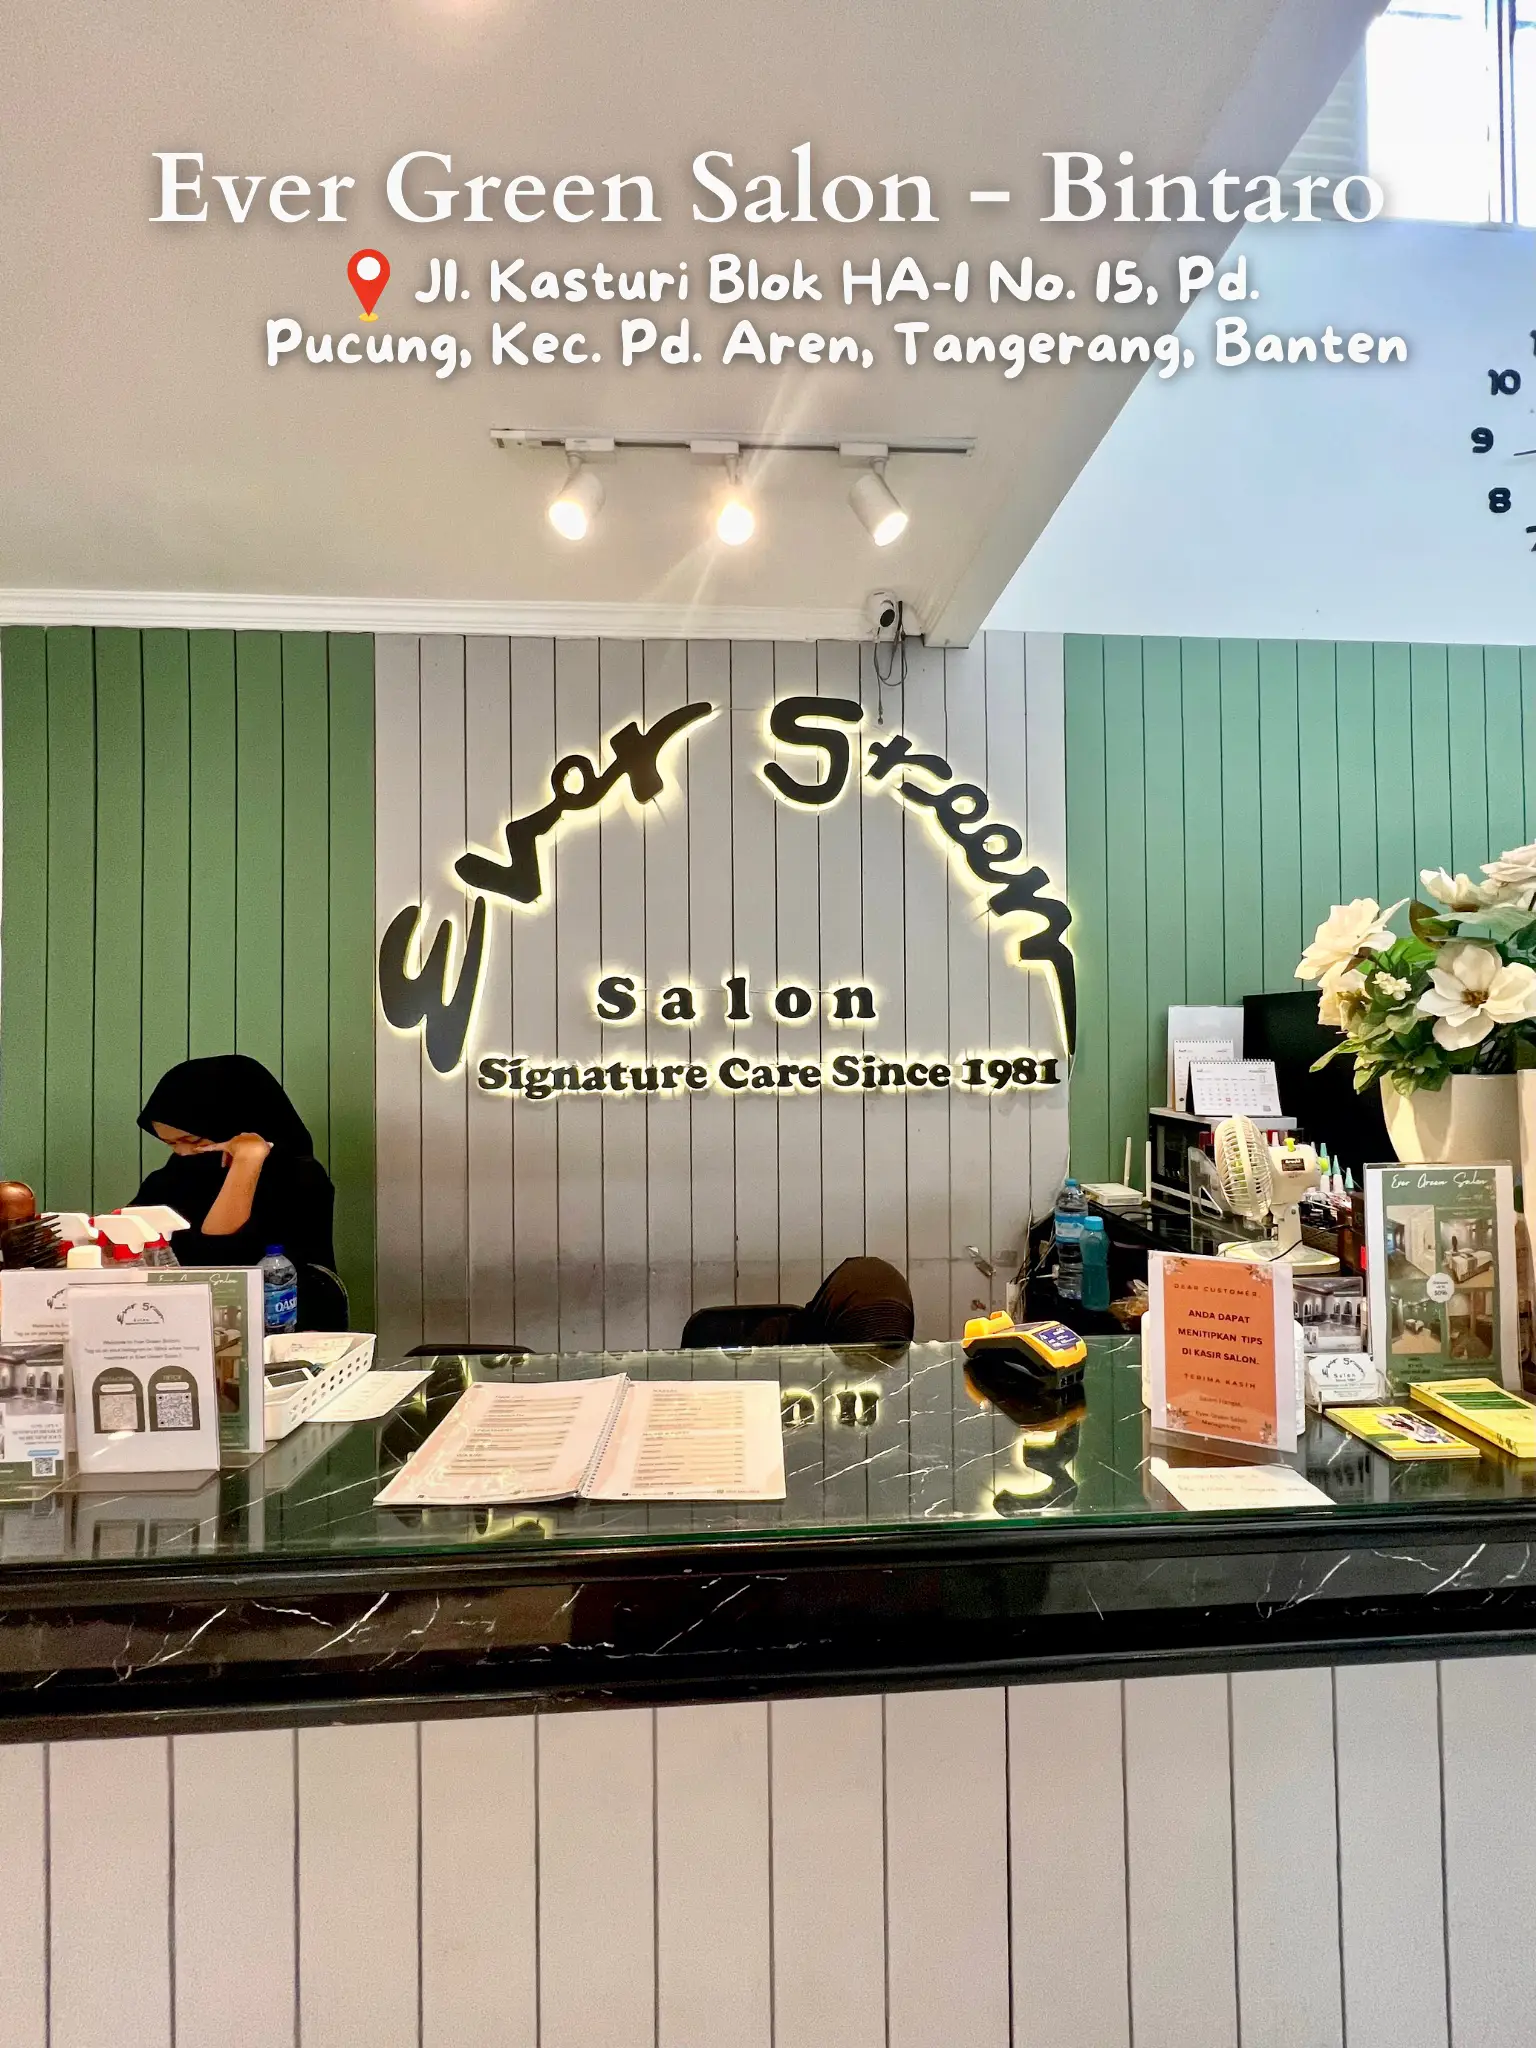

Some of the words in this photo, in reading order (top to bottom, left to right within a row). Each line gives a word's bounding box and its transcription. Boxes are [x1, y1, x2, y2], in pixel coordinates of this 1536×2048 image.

[1488, 368, 1521, 396] 10
[1471, 426, 1494, 453] 9
[1488, 487, 1512, 514] 8
[379, 701, 712, 1074] Ever
[596, 976, 877, 1020] Salon
[478, 1058, 708, 1099] Signature
[719, 1057, 822, 1090] Care
[832, 1055, 951, 1089] Since
[962, 1057, 1062, 1086] 1981
[1173, 1283, 1199, 1291] DEAR
[275, 1297, 297, 1312] OAS
[1188, 1309, 1216, 1320] ANDA
[1218, 1313, 1250, 1324] DAPAT
[1177, 1327, 1237, 1342] MENITIPKAN
[1241, 1335, 1263, 1346] TIPS
[1181, 1347, 1191, 1356] DI
[1194, 1348, 1221, 1360] KASIR
[1223, 1353, 1260, 1365] SALON.
[1184, 1373, 1221, 1384] TERIMA
[1225, 1379, 1256, 1390] KASIH
